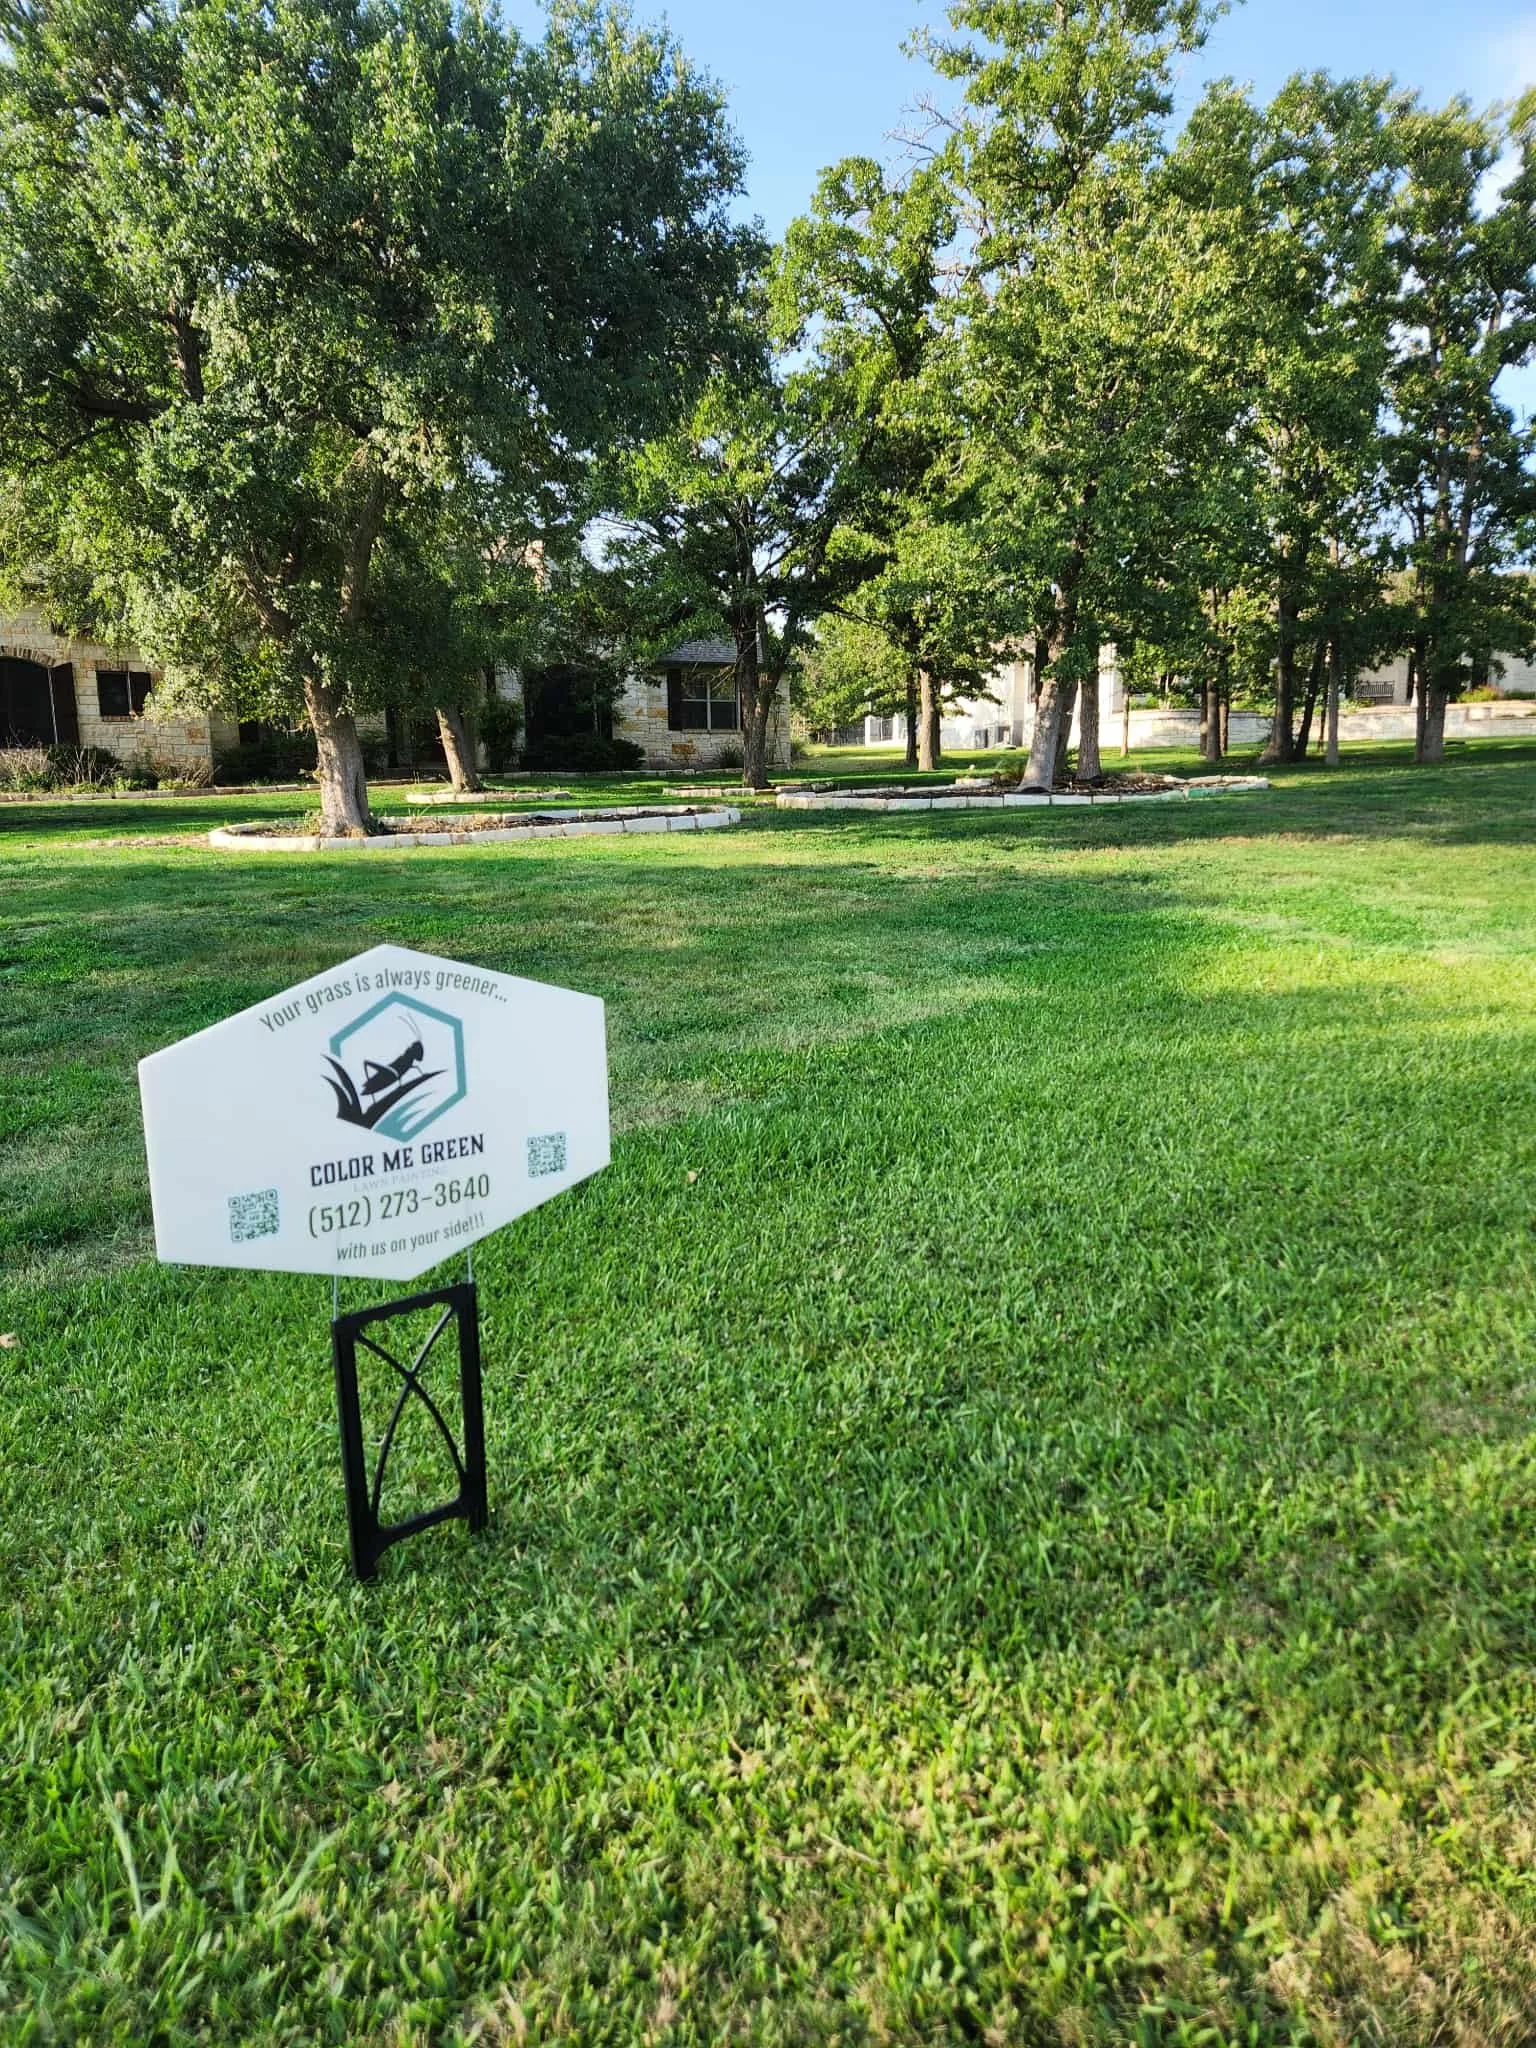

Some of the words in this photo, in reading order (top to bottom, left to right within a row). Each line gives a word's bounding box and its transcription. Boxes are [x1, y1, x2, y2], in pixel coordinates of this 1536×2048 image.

[260, 1001, 302, 1033] Your
[305, 980, 353, 1014] grass
[354, 972, 371, 993] is
[375, 968, 431, 989] always
[436, 970, 508, 1003] greener...
[310, 1154, 375, 1187] COLOR
[383, 1147, 414, 1173] ME
[421, 1133, 485, 1165] GREEN
[309, 1195, 371, 1239] (512)
[380, 1173, 490, 1220] 273-3640
[336, 1242, 367, 1261] with
[371, 1241, 386, 1256] us
[390, 1238, 407, 1253] on
[410, 1229, 440, 1252] your
